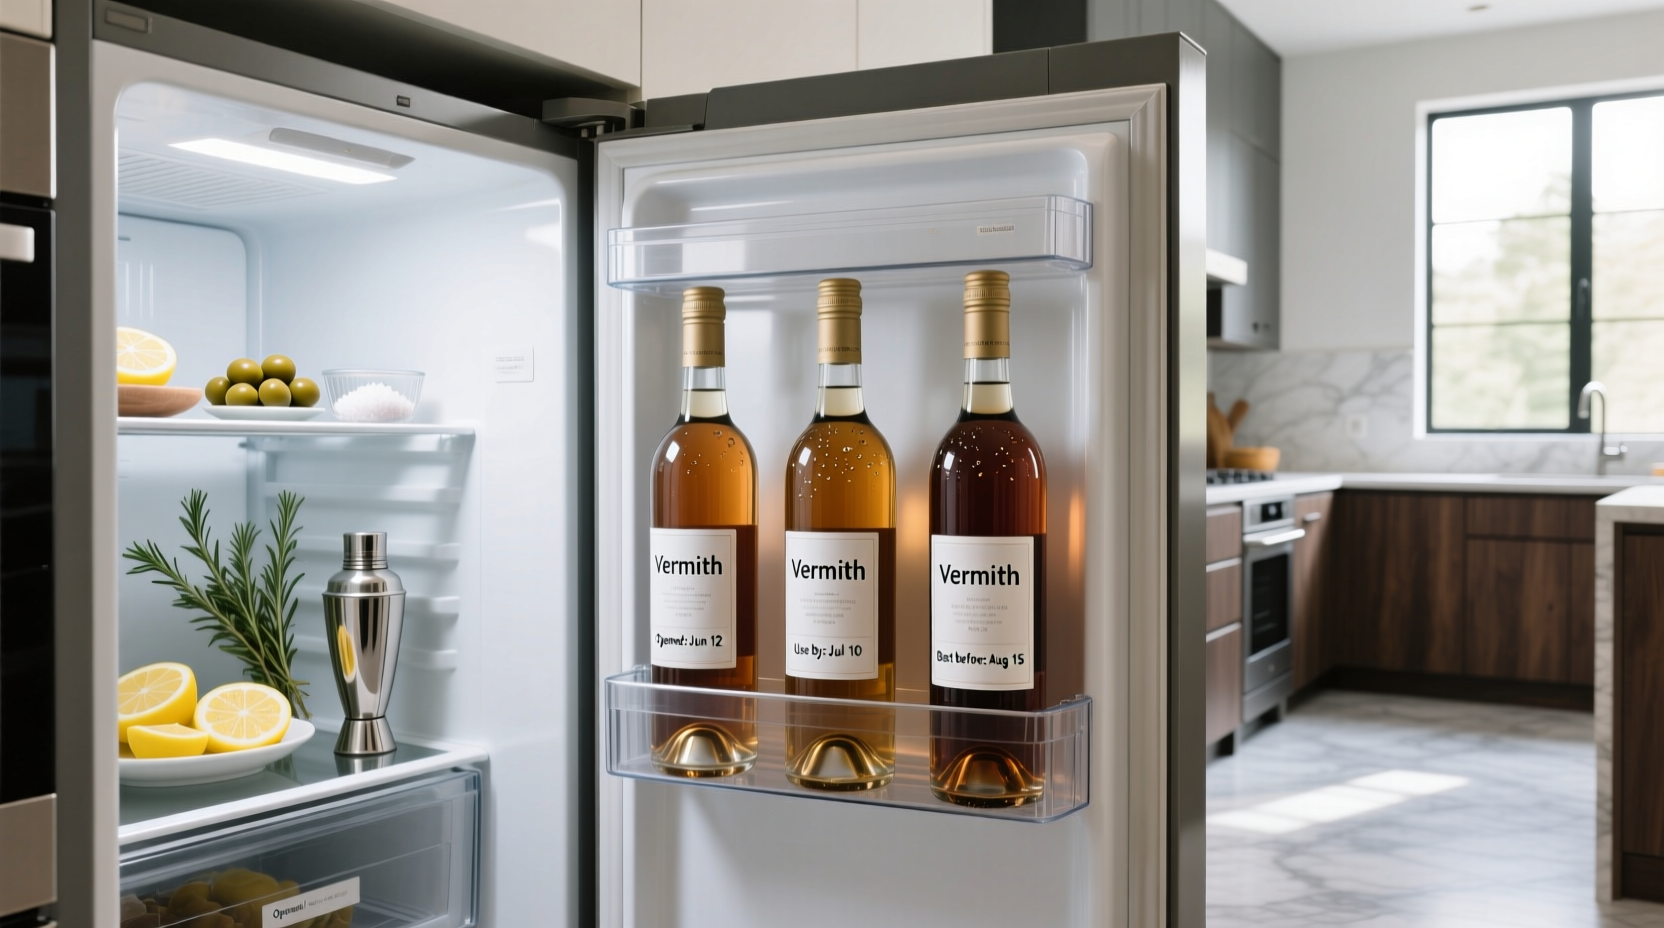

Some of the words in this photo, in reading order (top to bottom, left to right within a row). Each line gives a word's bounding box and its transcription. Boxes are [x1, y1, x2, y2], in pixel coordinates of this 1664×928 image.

[654, 554, 723, 575] Vermith
[791, 558, 866, 580] Vermith
[939, 563, 1020, 586] Vermith
[689, 634, 707, 647] Jun
[711, 634, 724, 647] 12
[794, 642, 809, 655] Use
[811, 643, 827, 660] by:
[828, 643, 845, 657] Jul
[848, 644, 863, 657] 10
[989, 653, 1009, 670] Aug
[1012, 653, 1025, 666] 15
